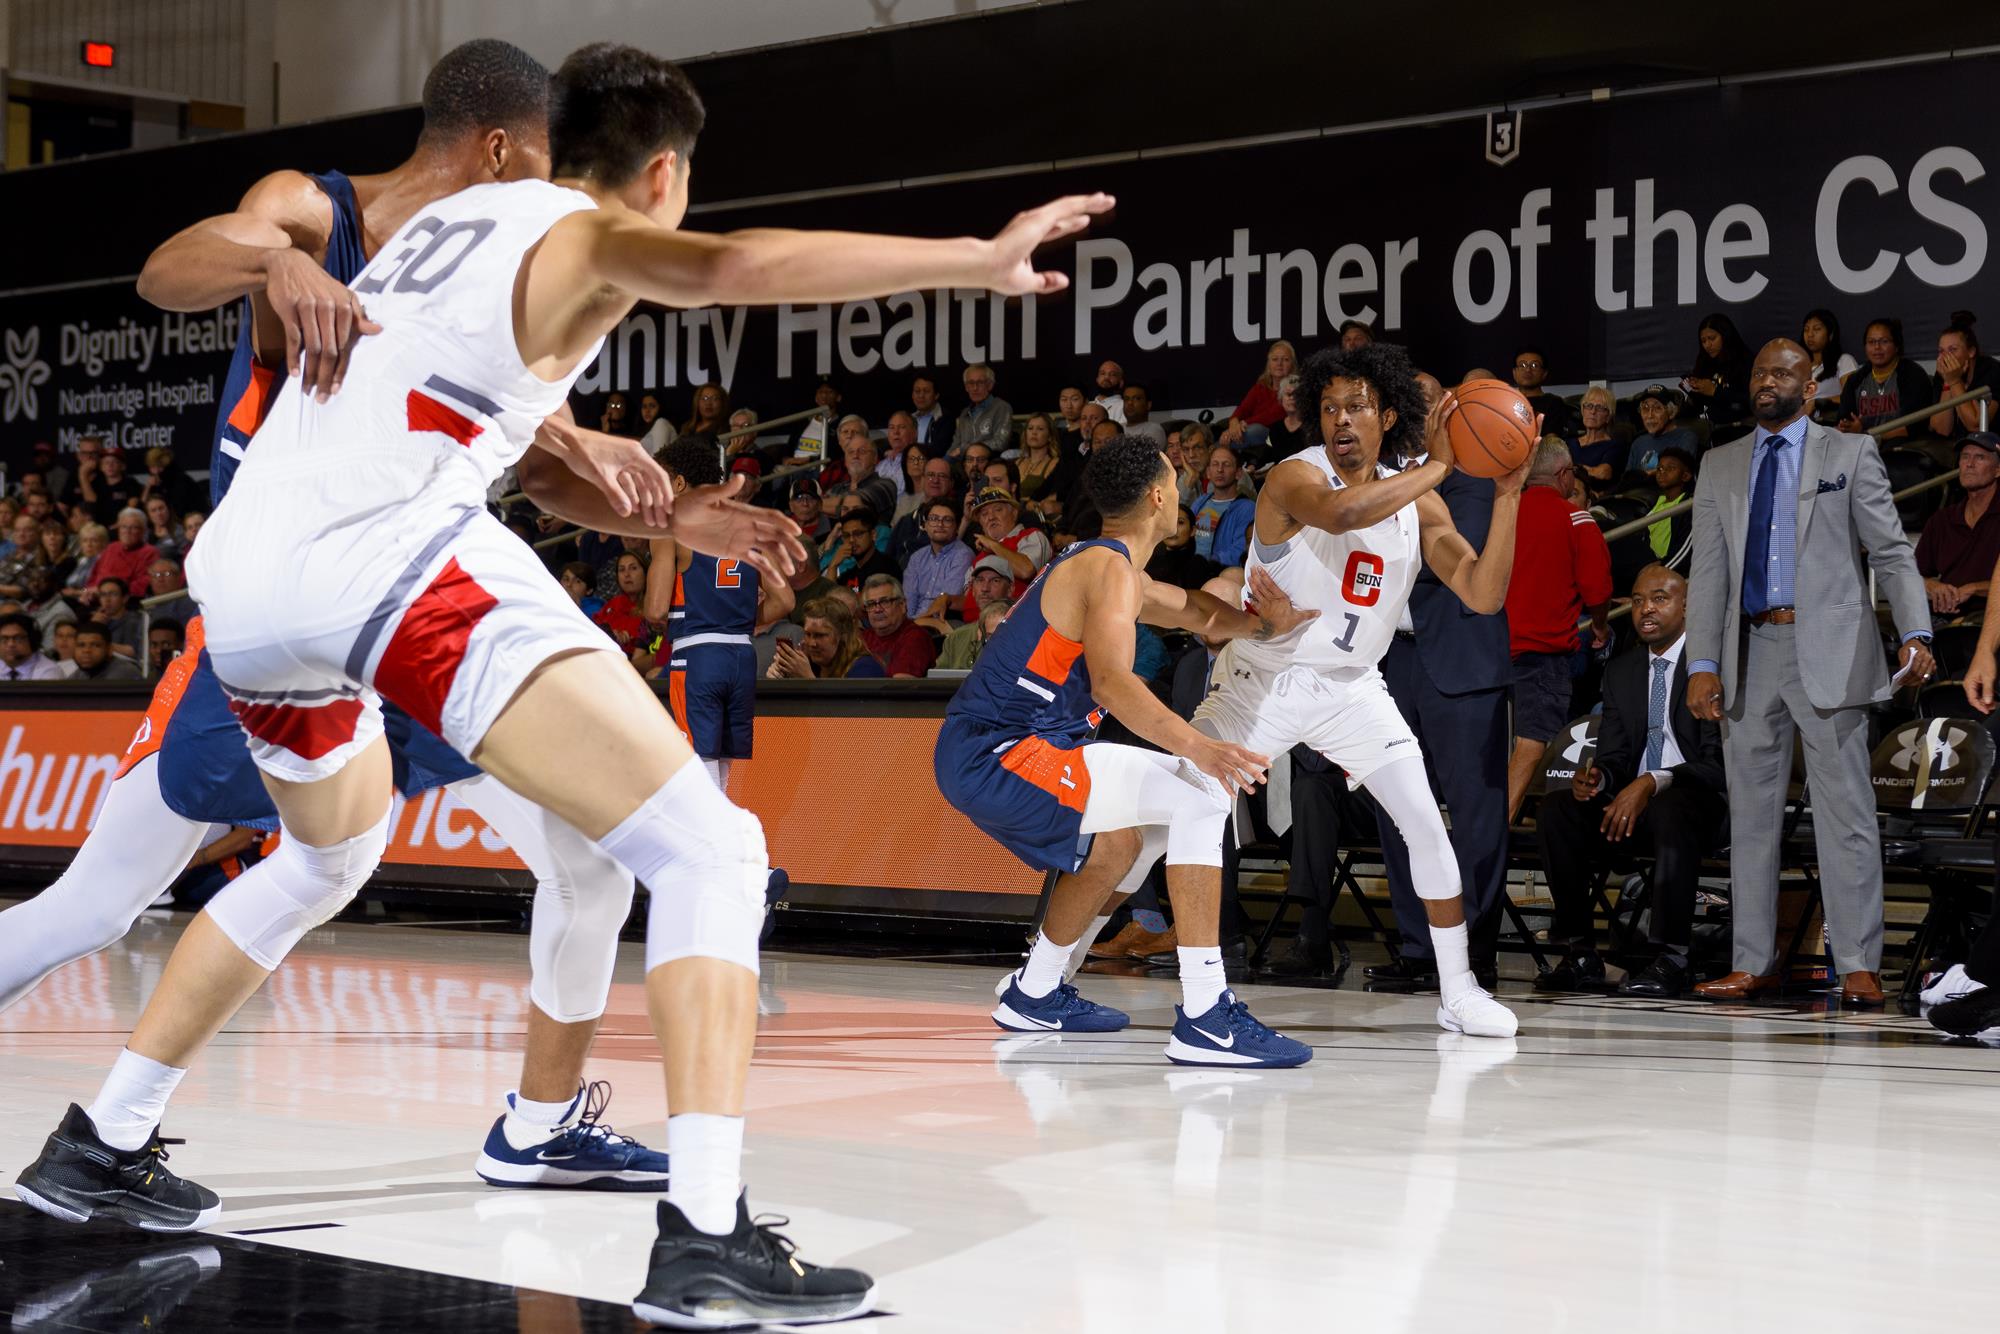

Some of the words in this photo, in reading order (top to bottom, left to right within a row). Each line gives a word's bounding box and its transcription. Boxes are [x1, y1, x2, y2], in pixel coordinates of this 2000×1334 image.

[1495, 121, 1511, 151] 3
[777, 287, 1037, 379] Health
[1075, 228, 1419, 355] Partner
[1452, 188, 1552, 324] of
[1585, 178, 1770, 312] the
[60, 316, 157, 377] Dignity
[58, 383, 144, 418] Northridge
[147, 375, 214, 414] Hospital
[121, 421, 176, 449] Center
[716, 558, 741, 588] 2
[1356, 572, 1383, 588] SUN
[1332, 611, 1360, 653] 1
[1546, 769, 1576, 778] UNDE
[1872, 776, 1915, 787] UNDER
[1928, 776, 1966, 787] RMOUR
